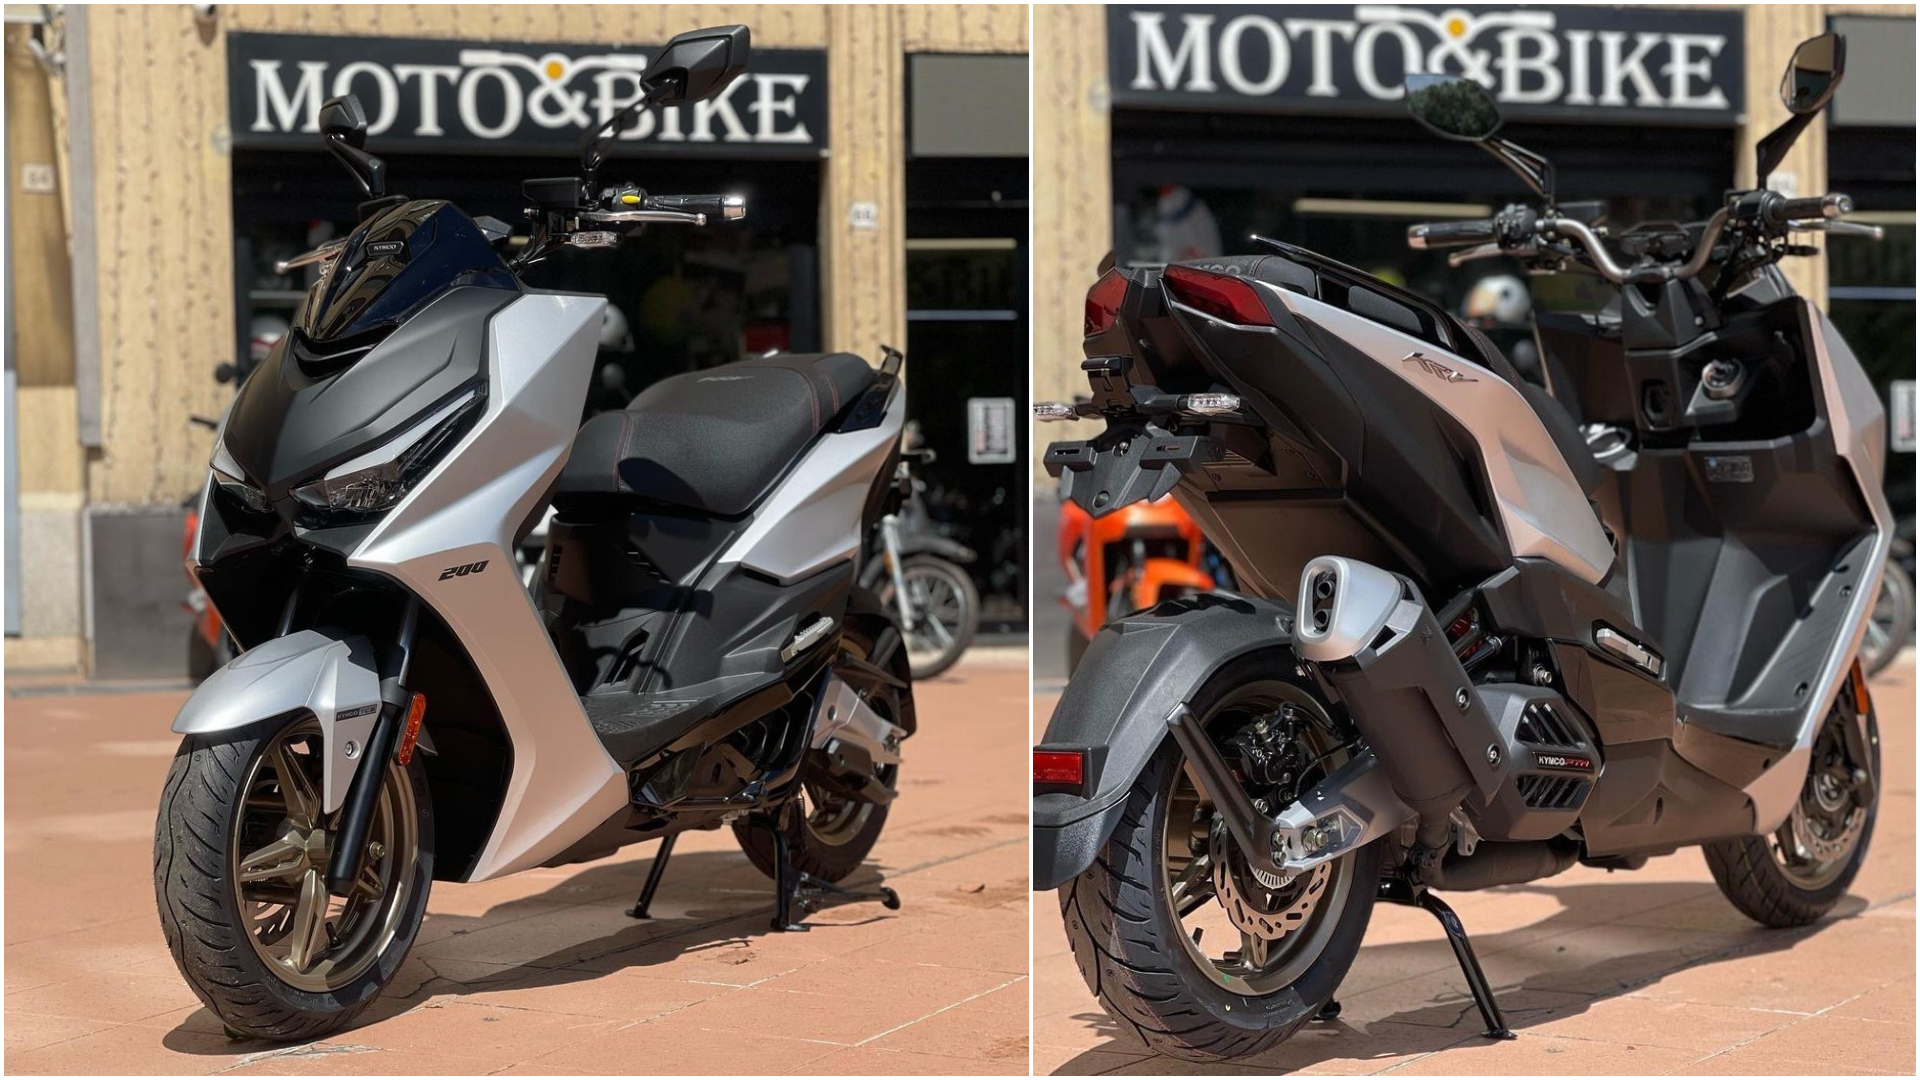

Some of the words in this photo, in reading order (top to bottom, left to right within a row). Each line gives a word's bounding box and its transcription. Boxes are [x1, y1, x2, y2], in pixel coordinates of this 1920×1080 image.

[1129, 8, 1730, 109] MOTO&BIKE
[438, 560, 489, 581] 200
[1538, 756, 1566, 766] KYMCO
